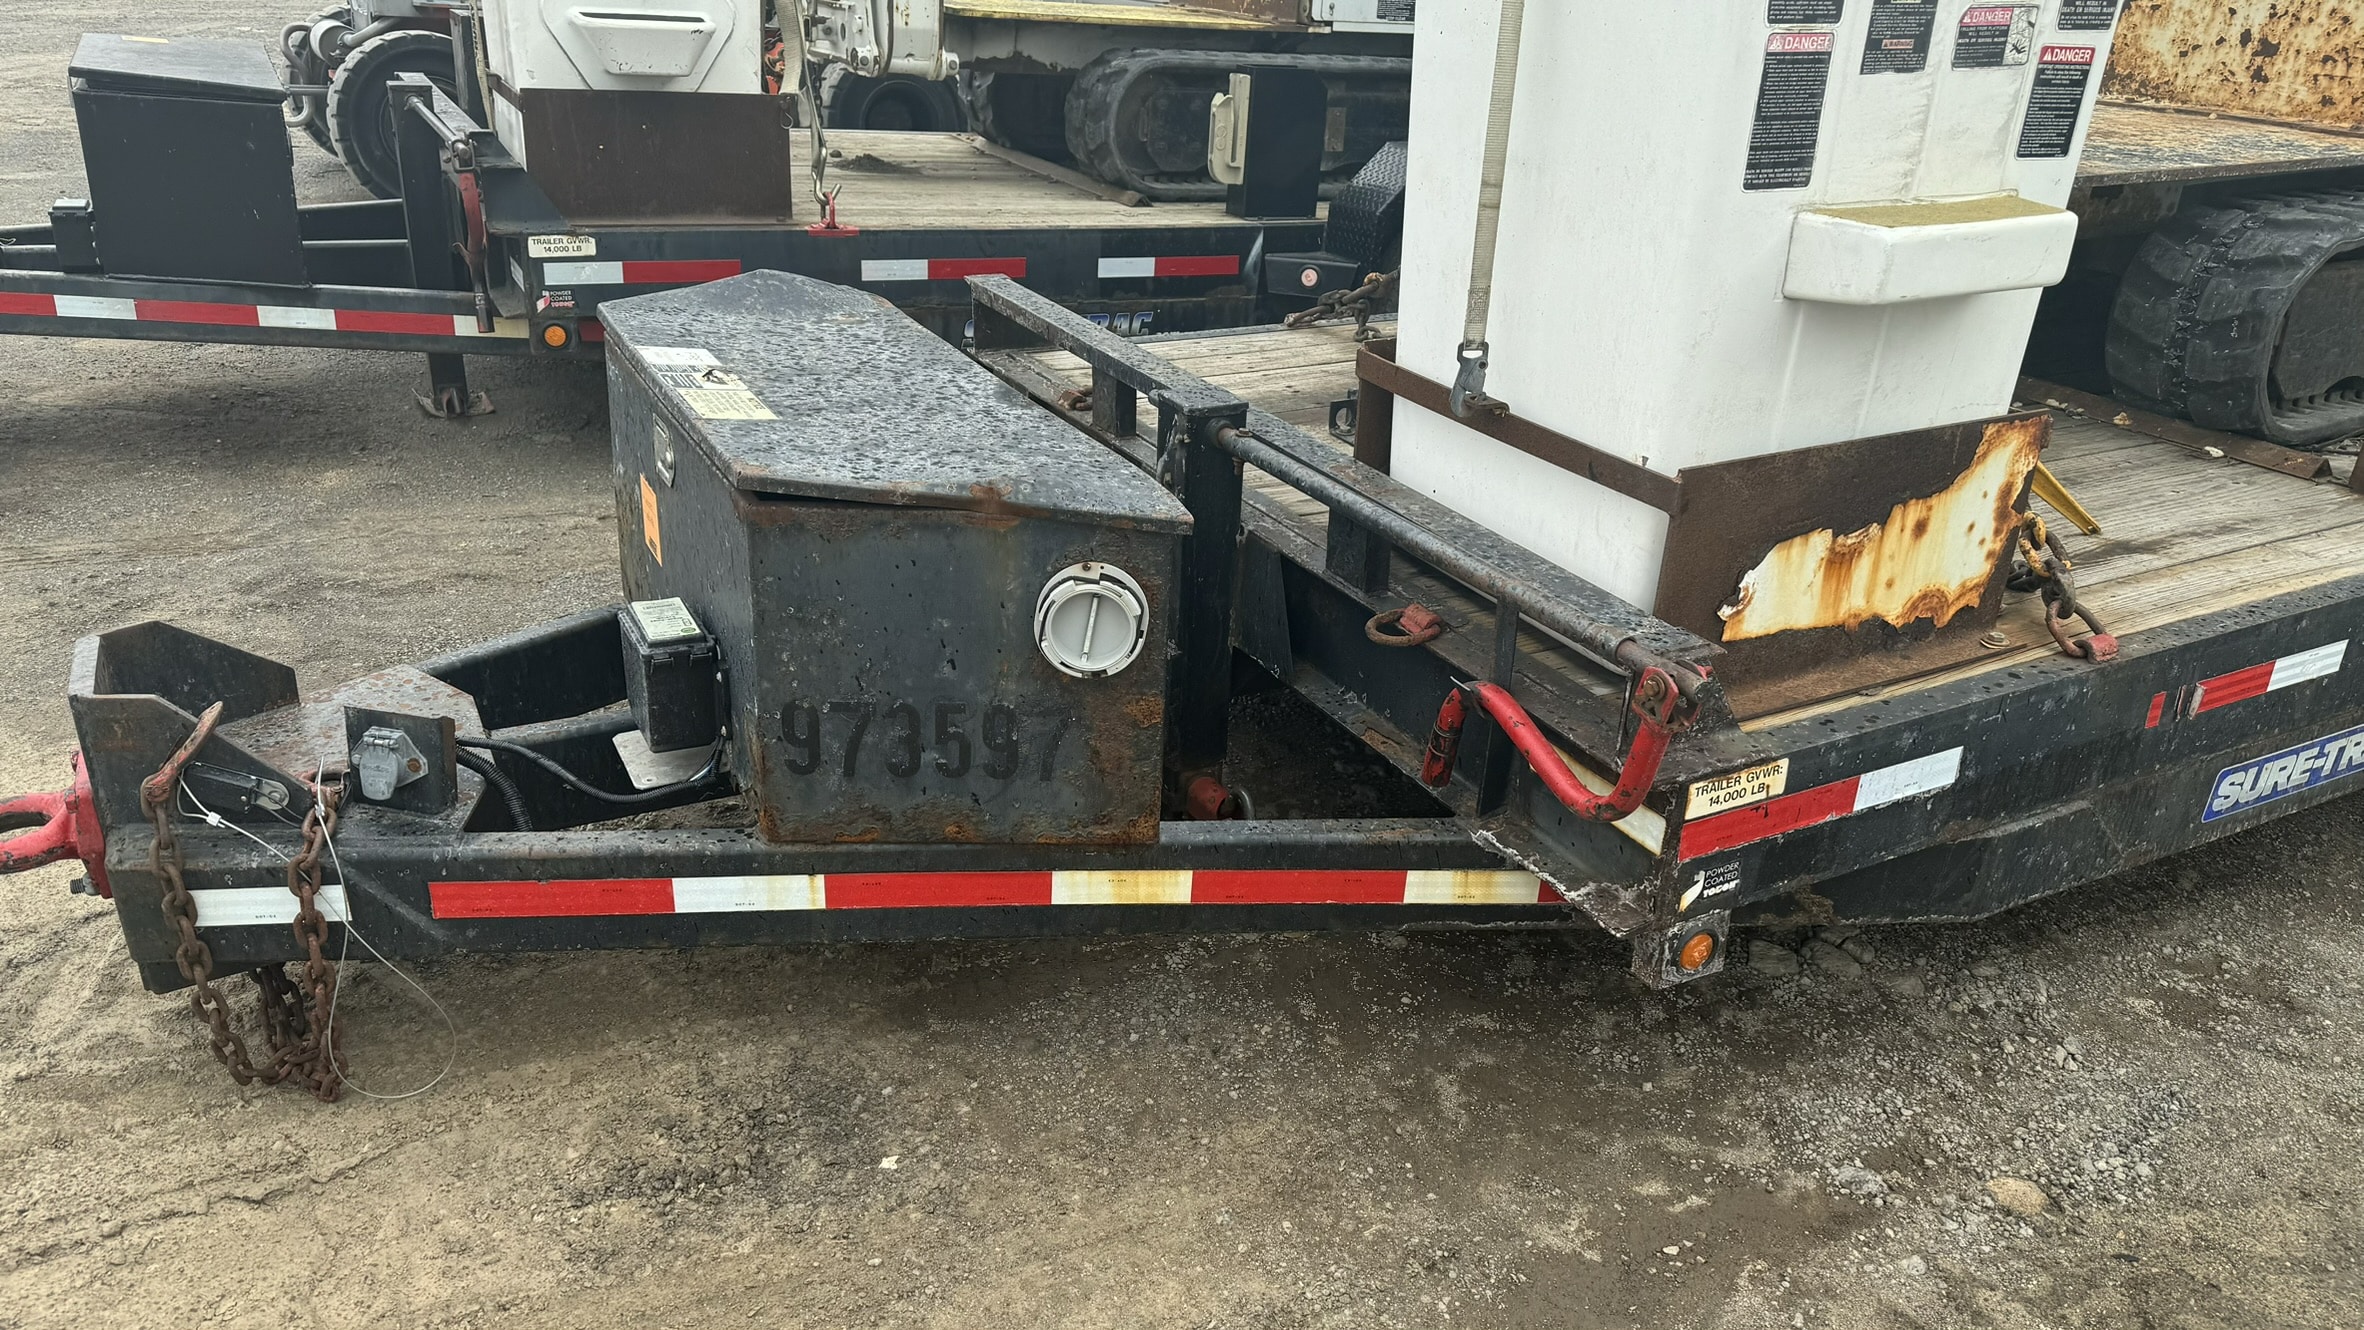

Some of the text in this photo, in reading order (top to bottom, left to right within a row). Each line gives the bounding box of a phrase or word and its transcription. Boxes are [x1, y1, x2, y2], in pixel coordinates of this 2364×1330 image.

[1972, 11, 2011, 23] DANGER
[2052, 48, 2092, 62] DANGER
[531, 237, 564, 245] TRAILER
[543, 245, 569, 253] 14,000
[781, 699, 1074, 782] 973597
[2212, 732, 2364, 812] SURE-TR
[1695, 764, 1784, 798] TRAILER GVWR:
[1708, 782, 1766, 807] 14,000 LB
[1705, 861, 1740, 879] POWDER
[1704, 871, 1738, 887] COATED
